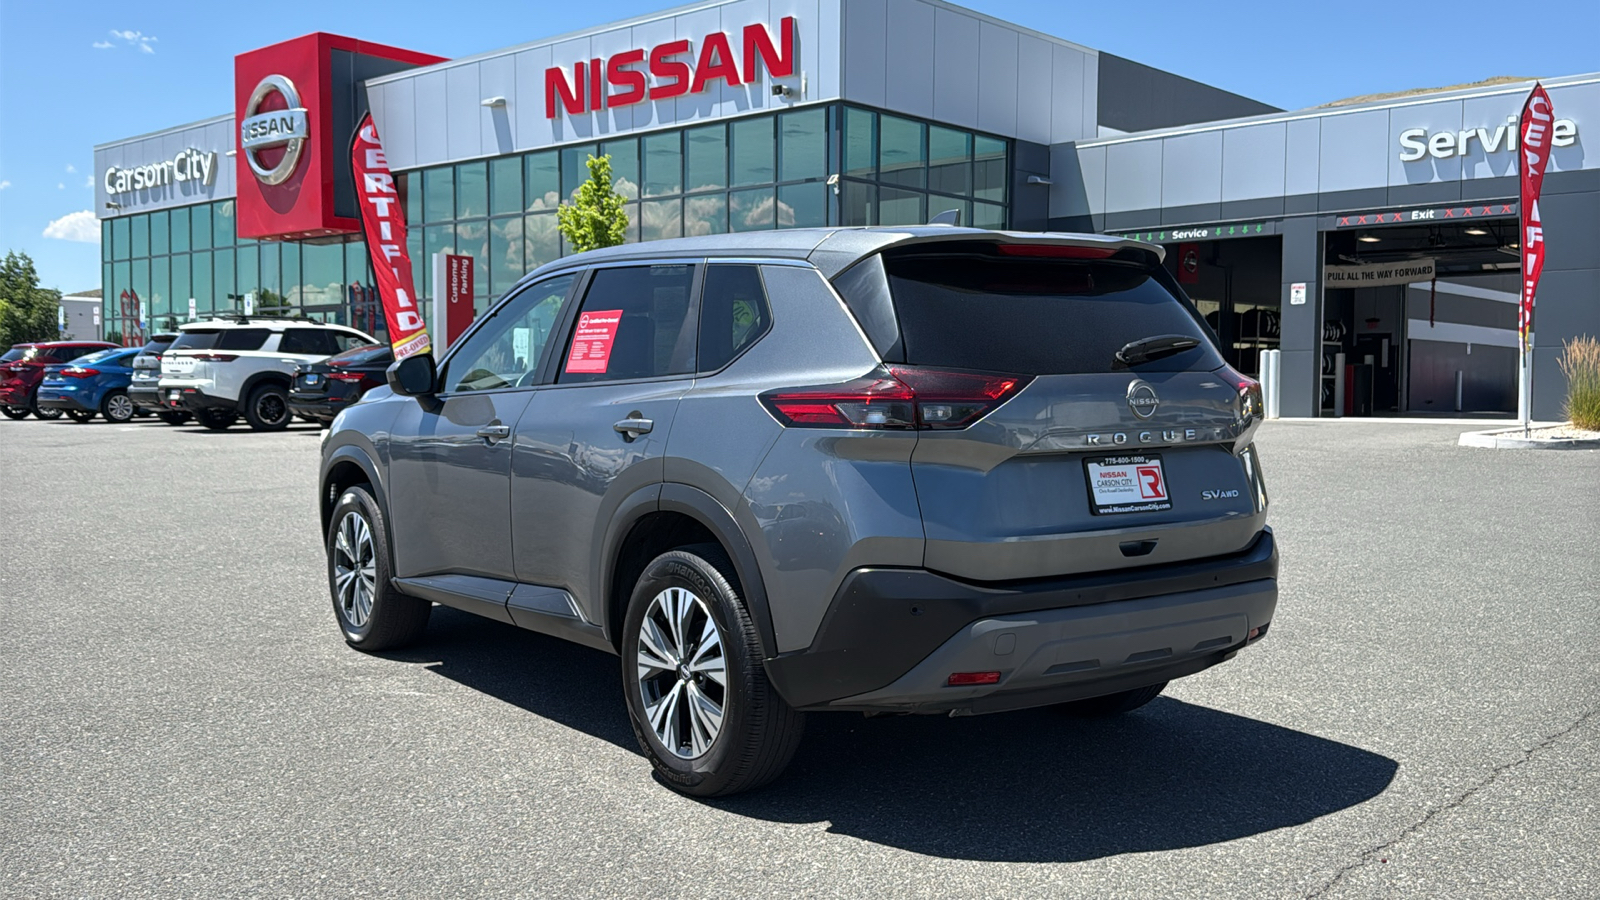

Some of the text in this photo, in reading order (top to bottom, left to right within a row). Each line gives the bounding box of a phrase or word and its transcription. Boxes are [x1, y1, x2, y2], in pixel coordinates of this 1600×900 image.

[545, 16, 793, 119] NISSAN
[1400, 115, 1577, 161] Servie
[105, 148, 216, 194] Carson City
[1411, 209, 1435, 220] Exit
[1172, 228, 1208, 240] Service
[461, 259, 469, 294] Parking
[1327, 265, 1433, 280] PULL ALL THE WAY FORWARD
[1087, 429, 1196, 445] ROGUE
[1121, 478, 1133, 486] CITY
